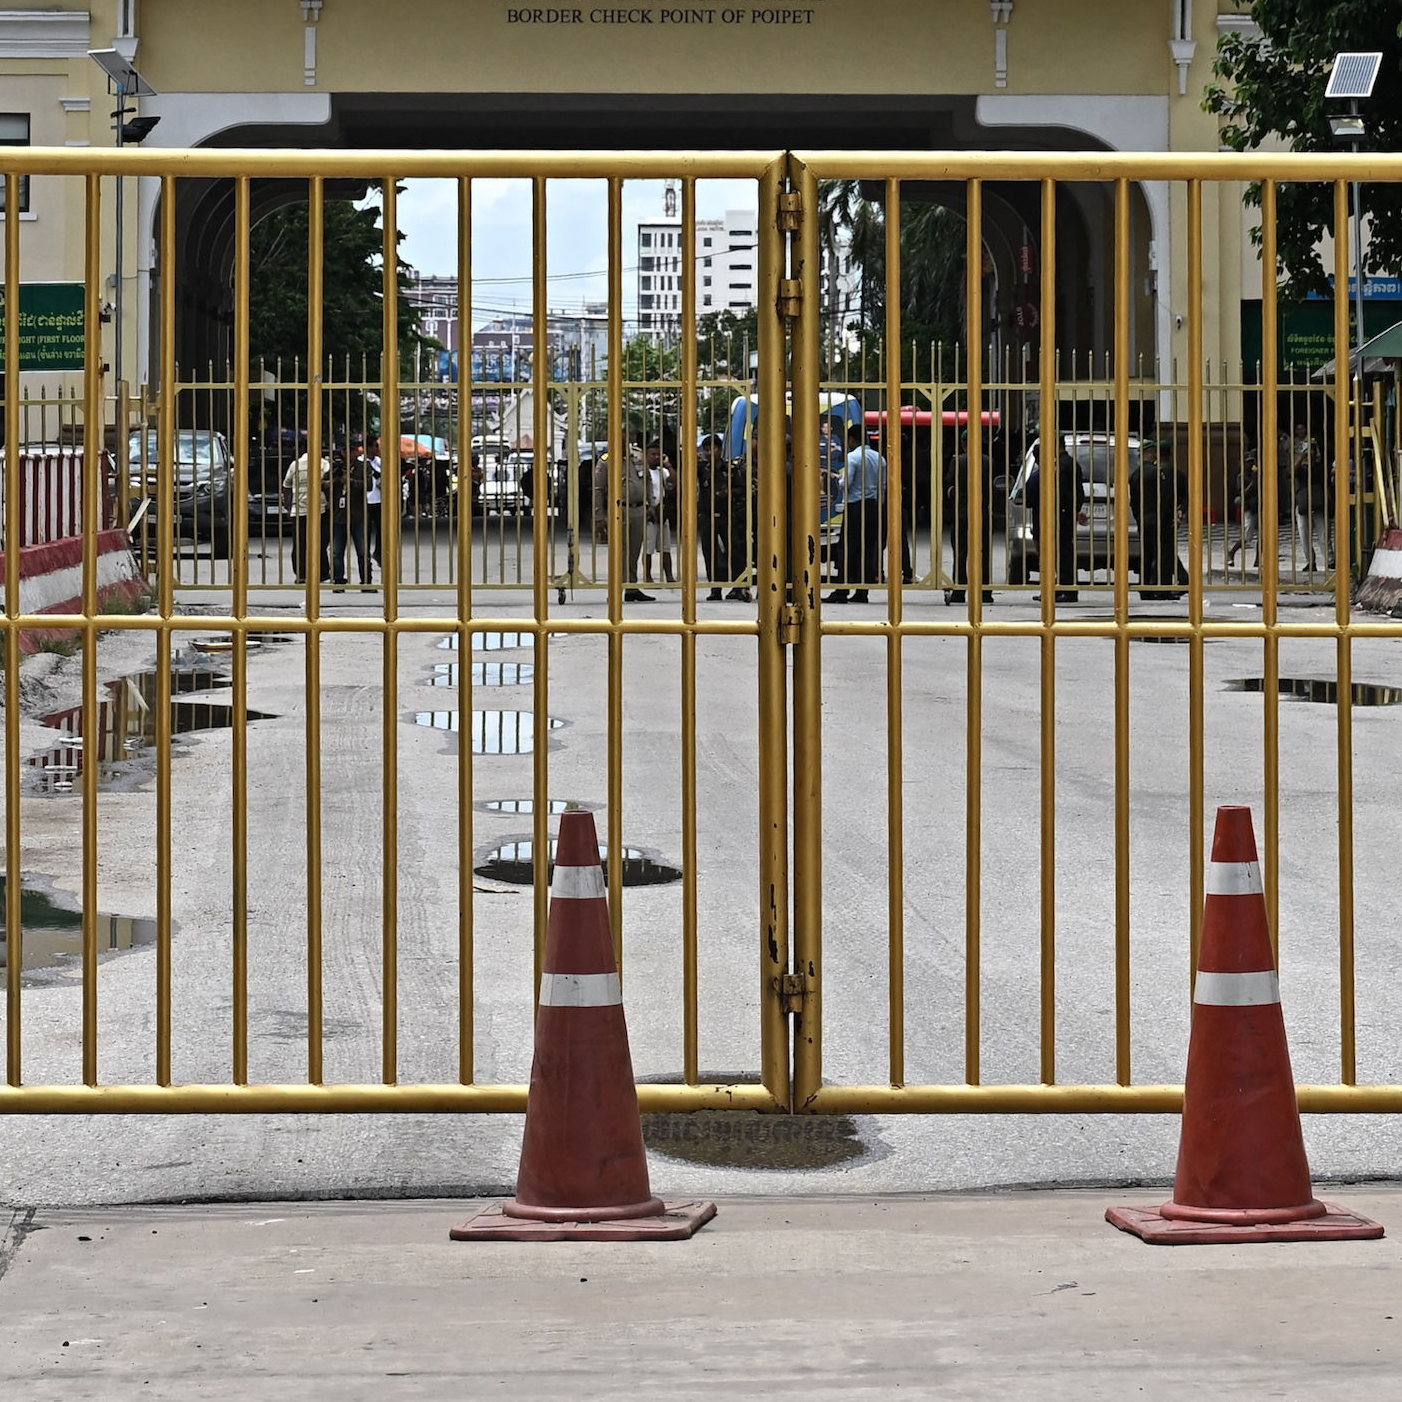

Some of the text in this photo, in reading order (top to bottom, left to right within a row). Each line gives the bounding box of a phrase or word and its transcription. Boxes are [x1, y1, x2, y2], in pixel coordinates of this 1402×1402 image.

[507, 9, 815, 24] BORDER CHECK POINT OF POIPET
[37, 335, 60, 344] (FIRST
[1291, 347, 1329, 355] FOREIGNER
